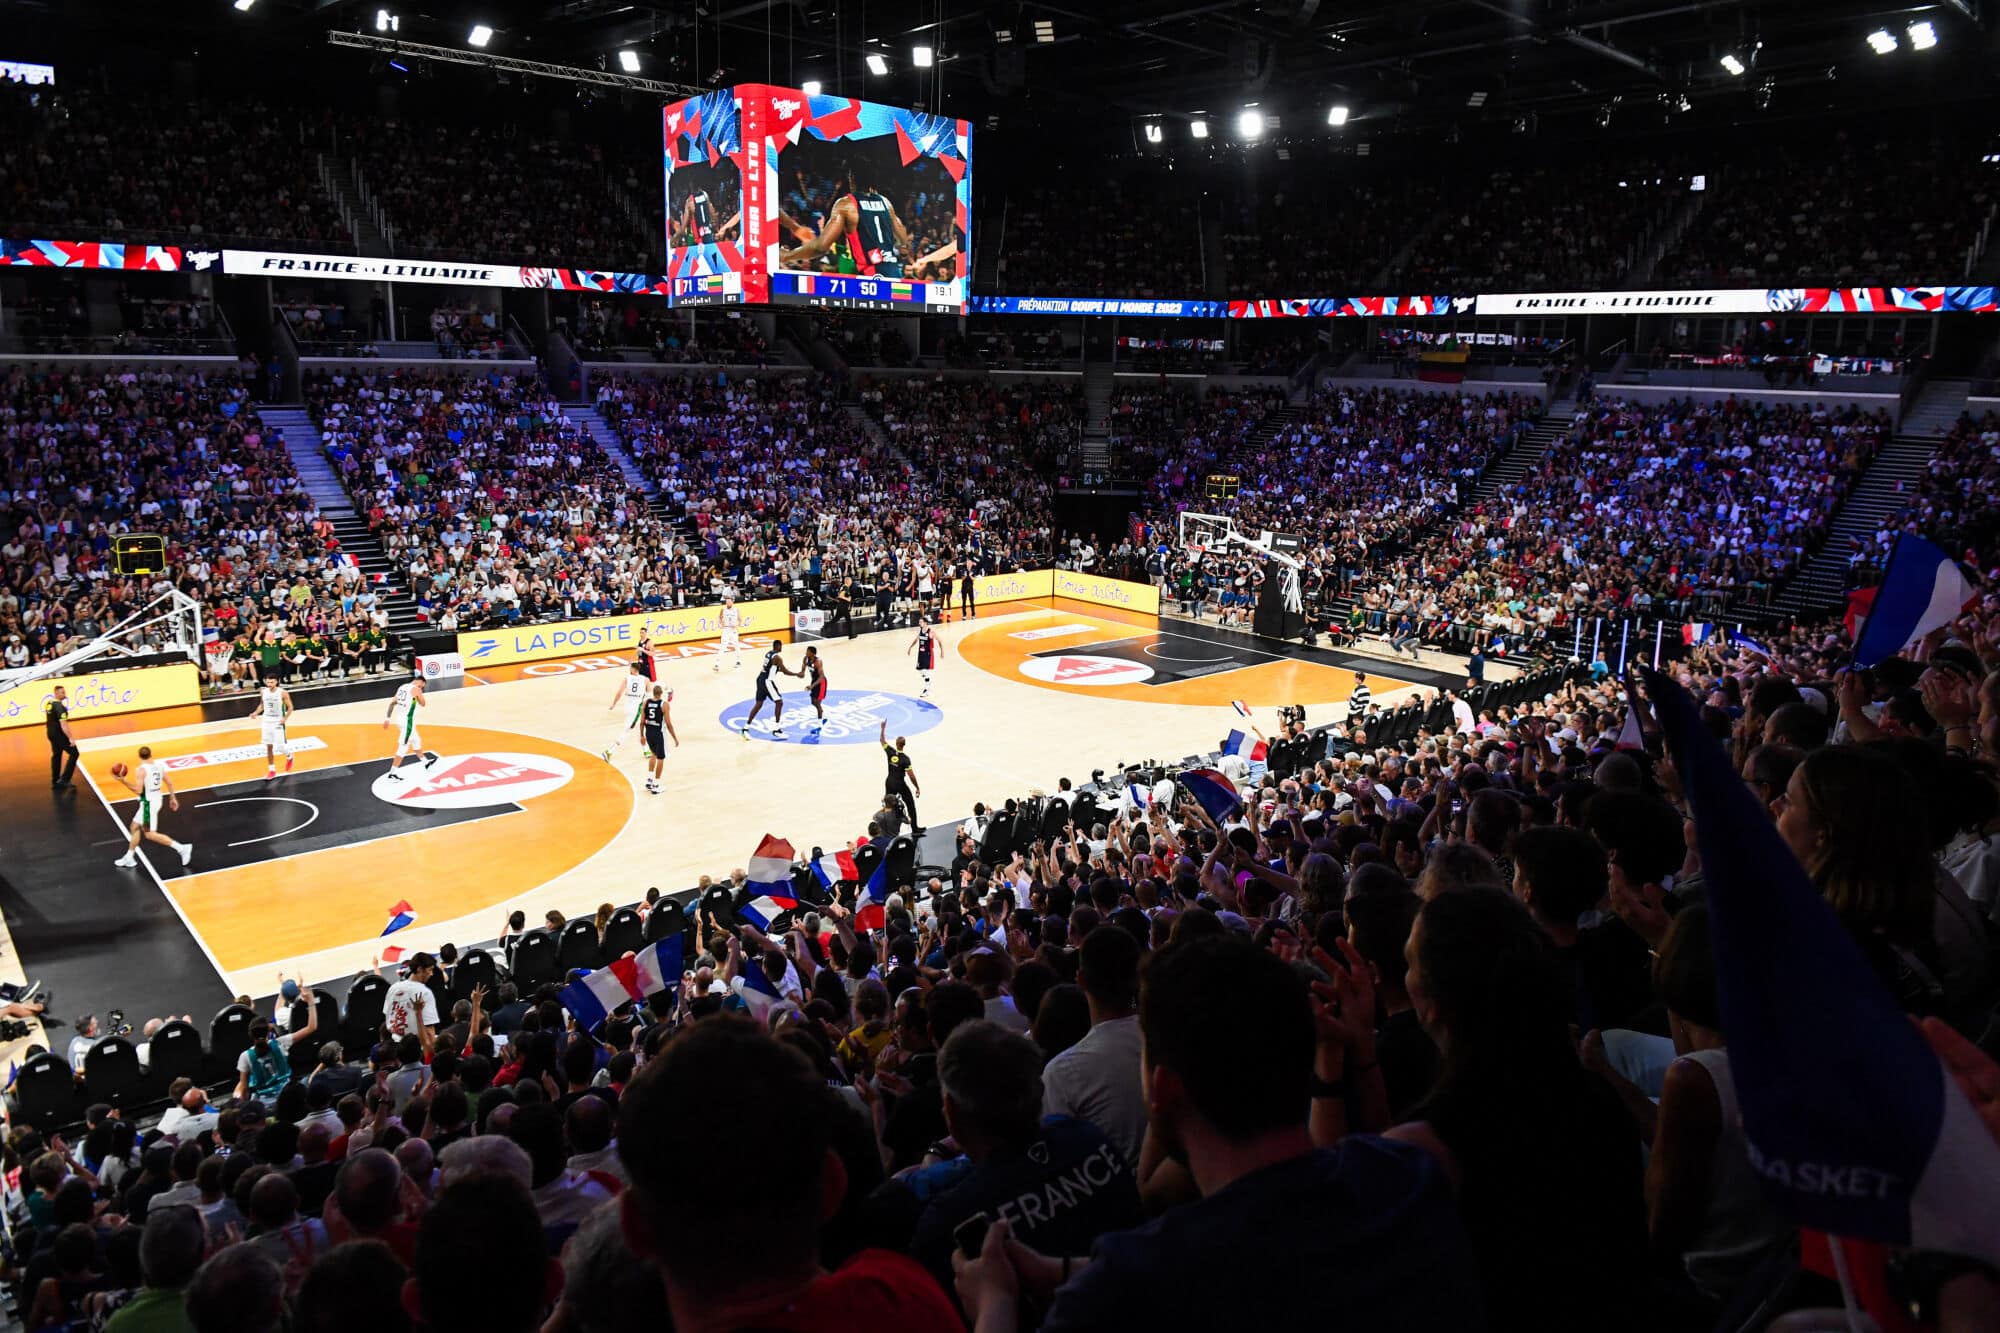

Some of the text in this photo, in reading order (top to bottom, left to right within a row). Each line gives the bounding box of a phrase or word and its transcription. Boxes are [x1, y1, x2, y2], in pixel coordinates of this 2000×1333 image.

[748, 141, 759, 181] LTU
[874, 215, 884, 243] 1
[262, 258, 358, 273] FRANCE
[382, 265, 494, 280] LITUANIE
[683, 278, 708, 293] 71 50
[830, 279, 878, 296] 71 50
[1017, 297, 1182, 314] PRÉPARATION COUPE DU MONDE 2023
[1516, 297, 1589, 308] FRANCE
[1610, 295, 1717, 307] LITUANIE
[515, 633, 547, 654] LA
[553, 623, 631, 648] POSTE
[631, 682, 639, 693] 8
[649, 708, 656, 719] 5
[417, 766, 529, 792] MAIF
[997, 1143, 1121, 1241] FRANCE
